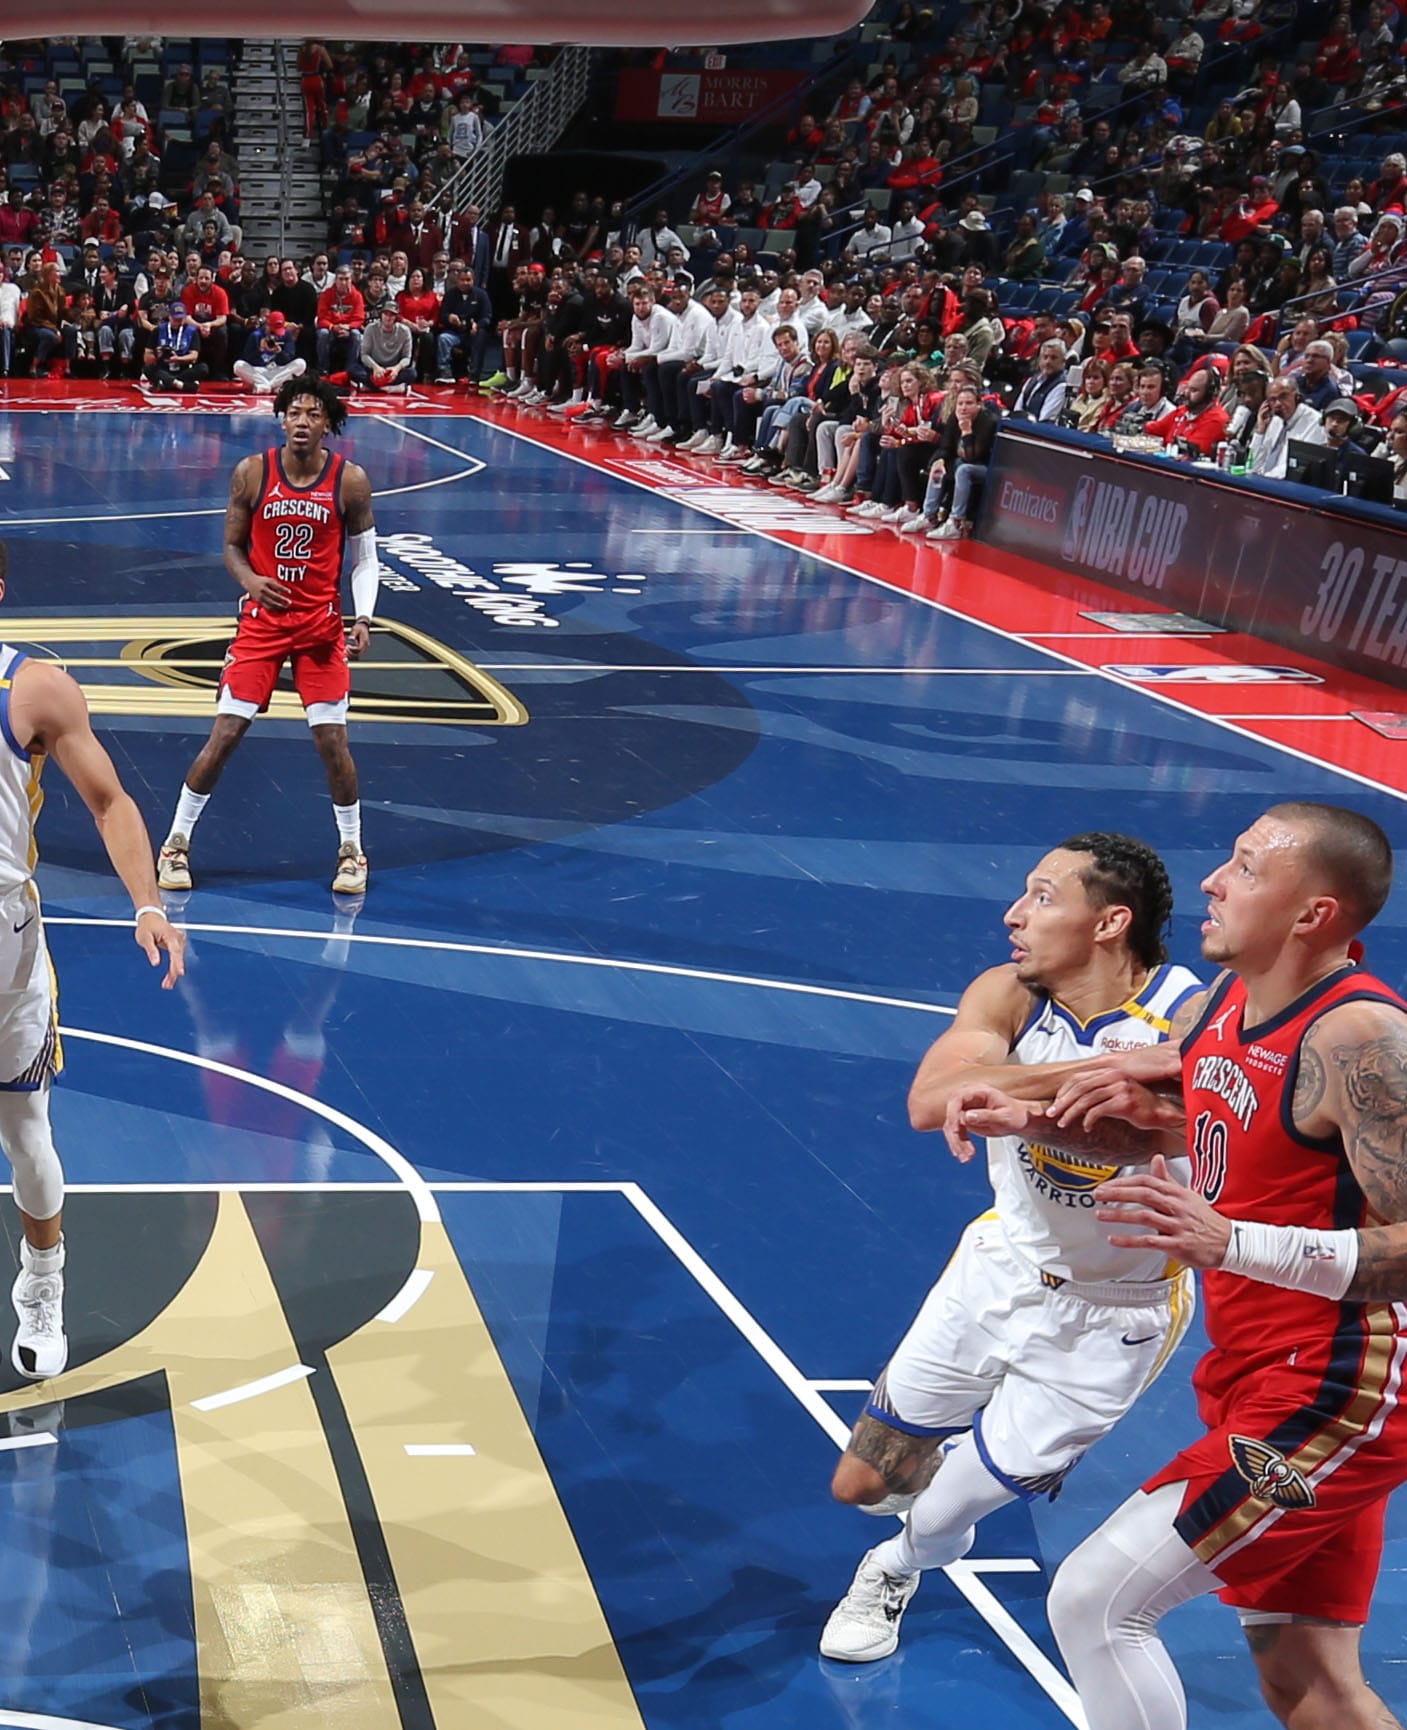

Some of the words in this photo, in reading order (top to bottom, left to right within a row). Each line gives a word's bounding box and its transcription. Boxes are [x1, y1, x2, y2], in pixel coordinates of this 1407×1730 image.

[704, 75, 768, 89] MORRIS
[704, 91, 759, 108] BART
[263, 499, 330, 524] CRESCENT
[1000, 481, 1059, 524] Emirates
[274, 522, 314, 560] 22
[1080, 481, 1140, 577] NBA
[1127, 495, 1189, 590] CUP
[277, 564, 307, 582] CITY
[1299, 541, 1366, 643] 30
[1247, 1044, 1288, 1066] NEWAGE
[1192, 1055, 1260, 1132] CRESCENT
[1017, 1143, 1096, 1209] WARRIO
[1193, 1110, 1229, 1206] 10
